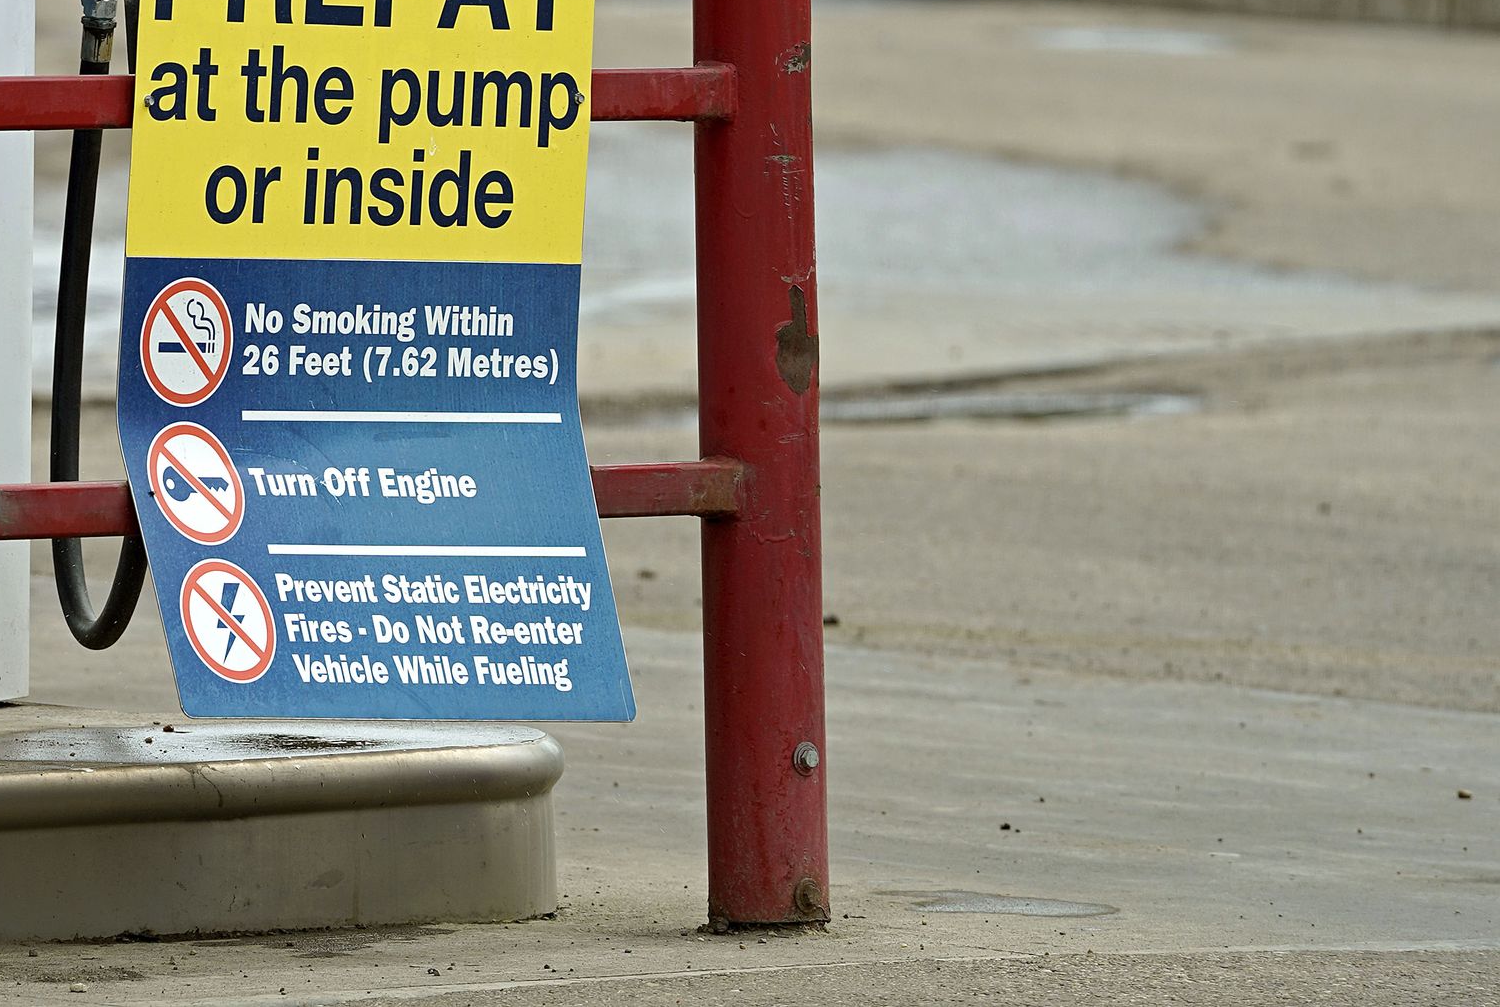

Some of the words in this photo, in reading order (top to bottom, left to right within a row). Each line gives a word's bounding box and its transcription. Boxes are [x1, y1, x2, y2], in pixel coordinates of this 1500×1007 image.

[148, 48, 218, 121] at
[241, 45, 354, 125] the
[379, 67, 580, 148] pump
[204, 164, 281, 224] or
[303, 147, 514, 229] inside
[244, 303, 284, 335] No
[292, 304, 415, 342] Smoking
[424, 305, 514, 337] Within
[242, 347, 280, 376] 26
[288, 347, 352, 377] Feet
[363, 346, 437, 384] (7.62
[447, 347, 559, 384] Metres)
[248, 467, 317, 497] Turn
[322, 467, 370, 497] Off
[377, 467, 477, 504] Engine
[275, 573, 377, 604] Prevent
[384, 574, 459, 604] Static
[464, 575, 592, 611] Electricity
[285, 614, 353, 643] Fires
[374, 615, 409, 644] Do
[415, 615, 465, 645] Not
[470, 616, 584, 645] Re-enter
[291, 655, 389, 685] Vehicle
[394, 655, 469, 686] While
[475, 656, 572, 691] Fueling
